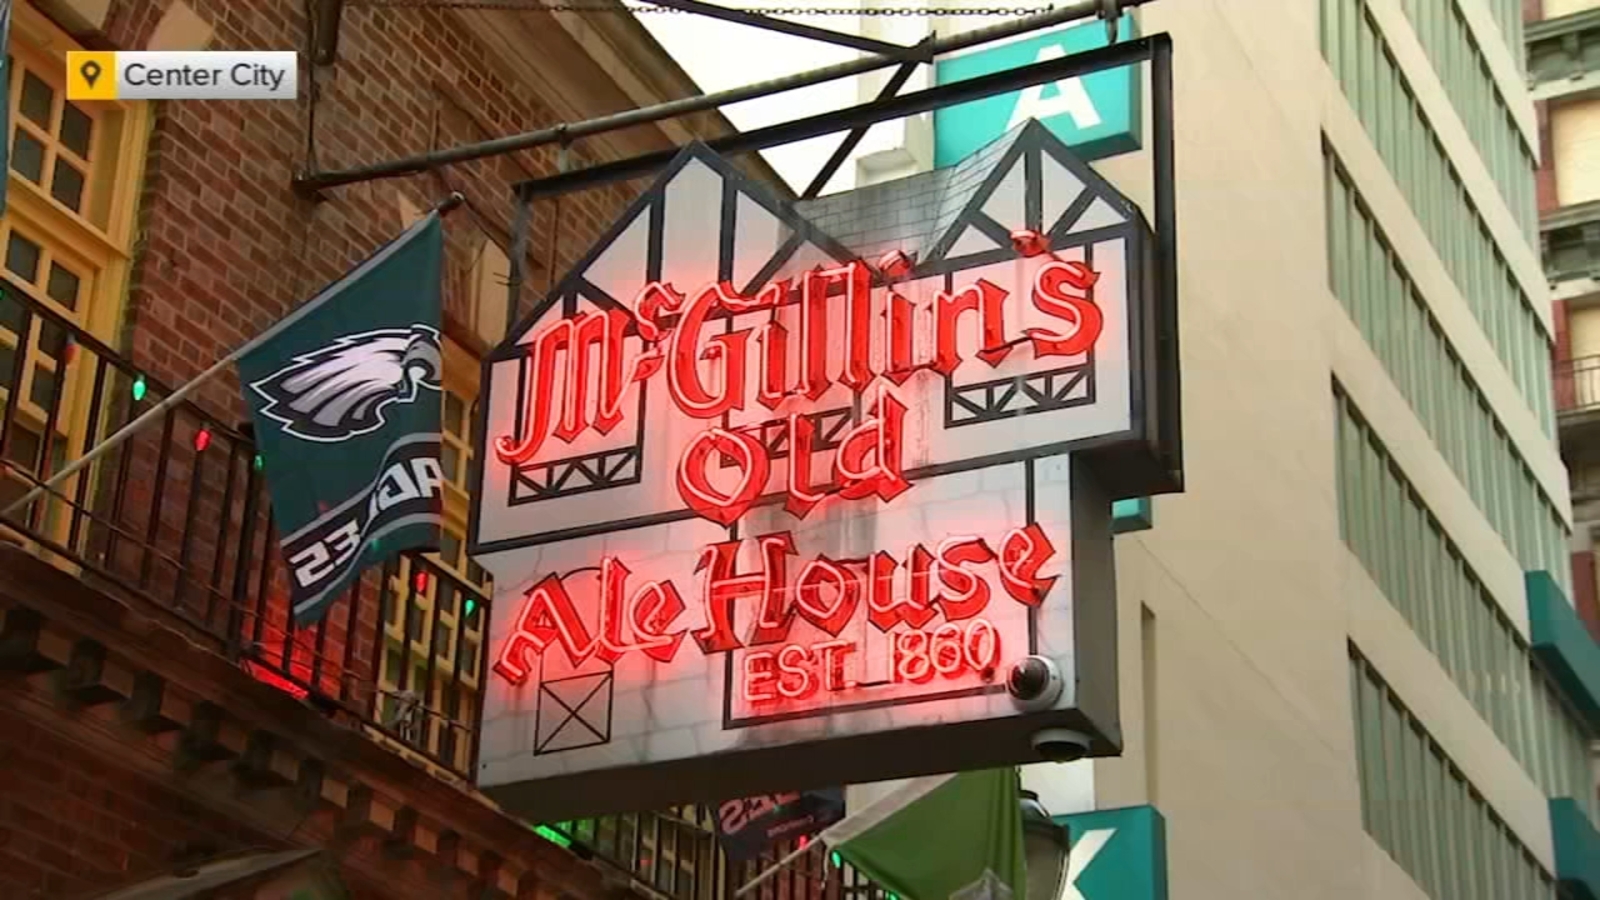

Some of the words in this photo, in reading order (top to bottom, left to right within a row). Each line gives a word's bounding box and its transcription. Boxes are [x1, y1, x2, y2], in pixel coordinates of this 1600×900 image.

[1004, 44, 1102, 132] A
[492, 556, 690, 685] Ale
[692, 522, 1063, 654] House
[889, 618, 1001, 684] 1860
